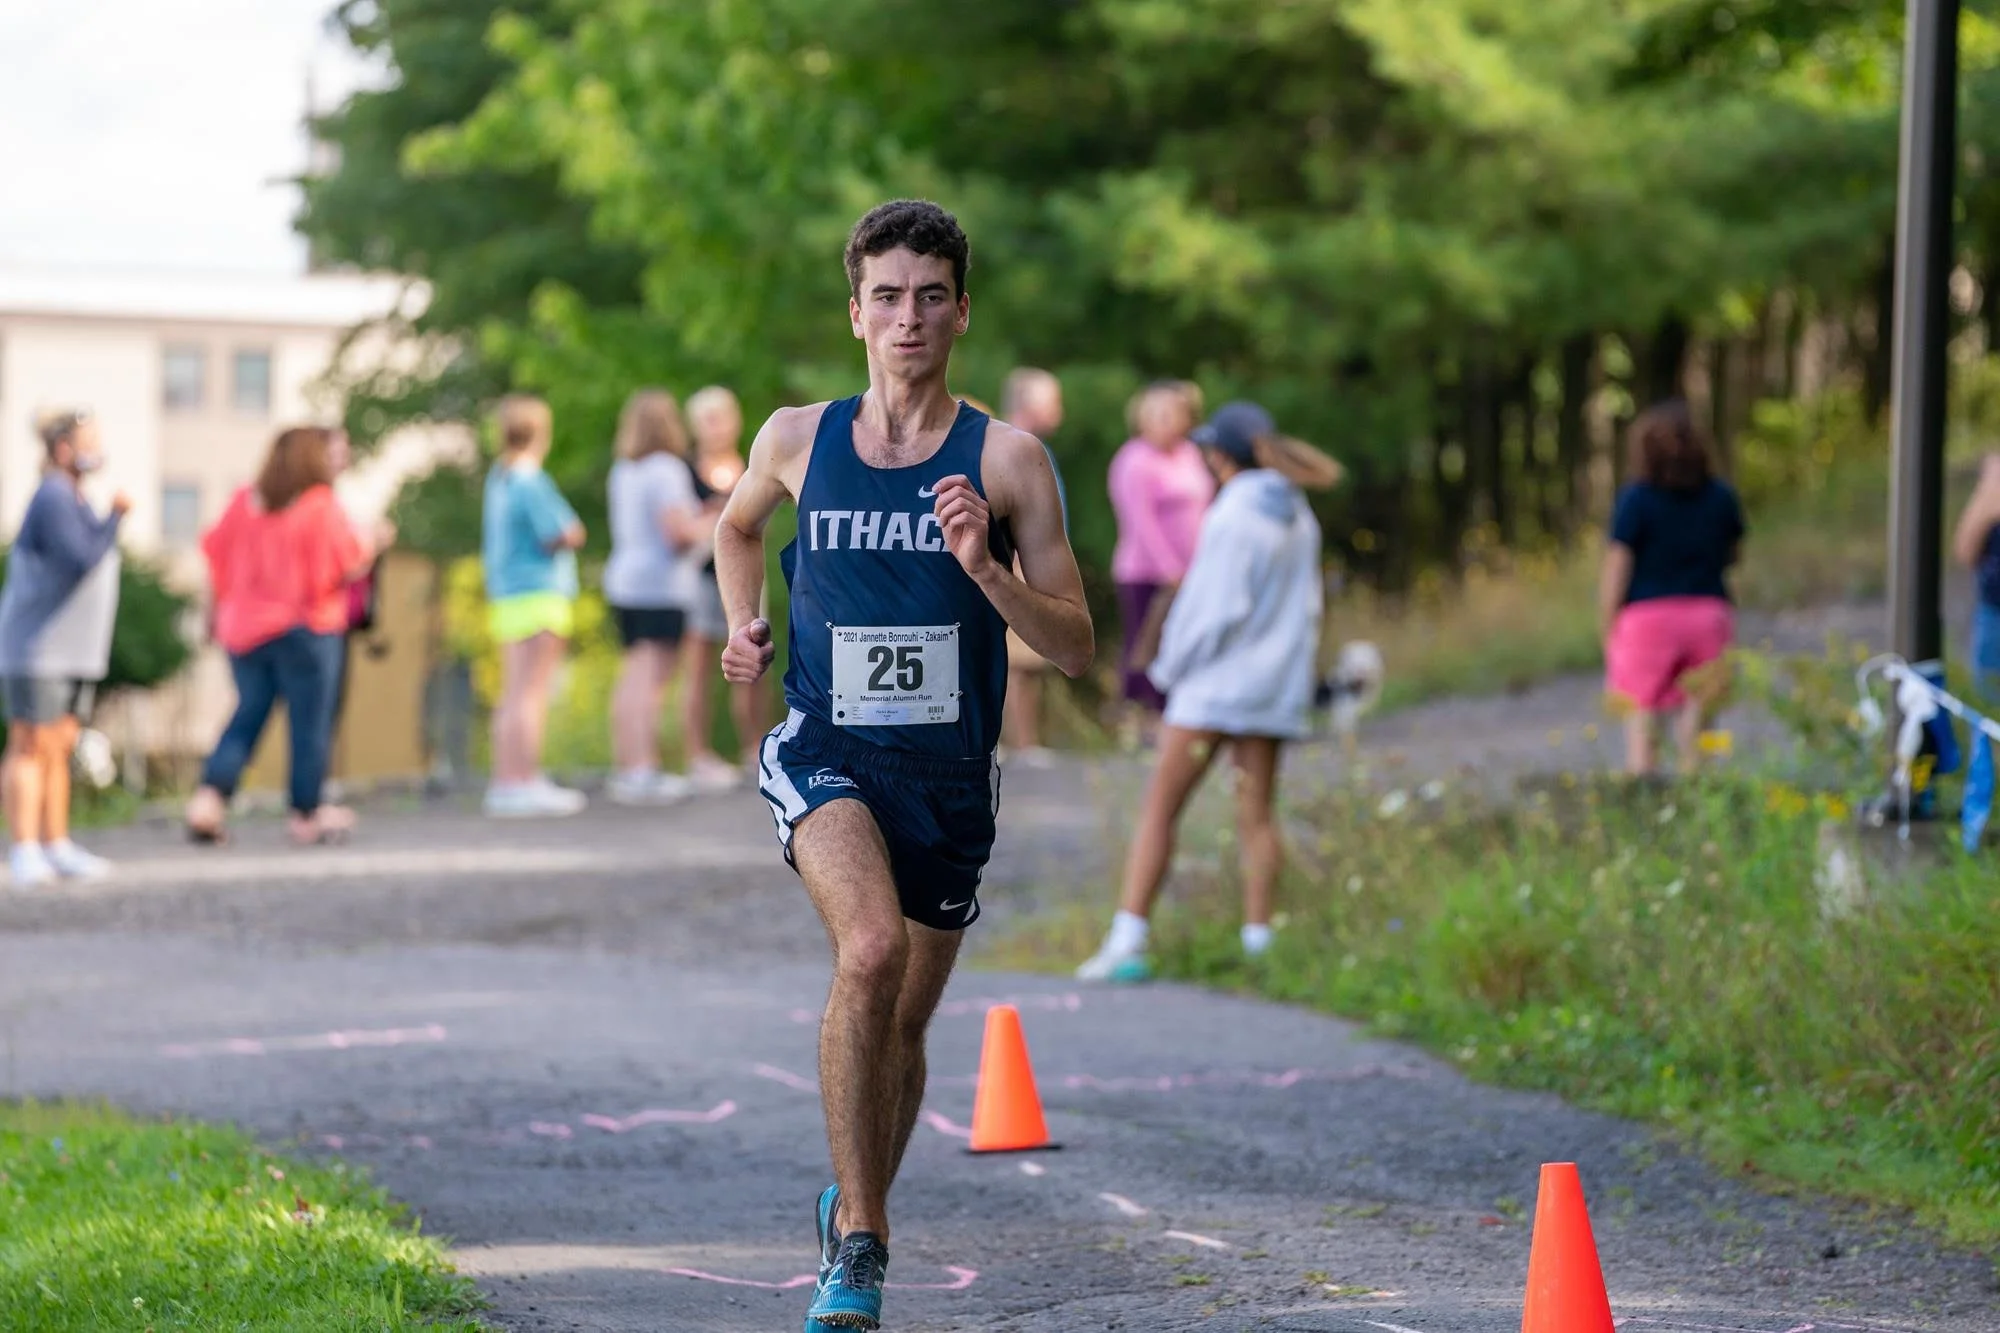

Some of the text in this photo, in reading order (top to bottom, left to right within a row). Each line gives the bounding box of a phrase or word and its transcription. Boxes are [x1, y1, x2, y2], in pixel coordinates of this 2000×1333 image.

[809, 510, 953, 552] ITHAC
[843, 632, 858, 642] 2021
[859, 632, 887, 642] Jannette
[888, 631, 918, 642] Bonrouhi
[925, 631, 948, 642] Zakaim
[867, 645, 923, 691] 25
